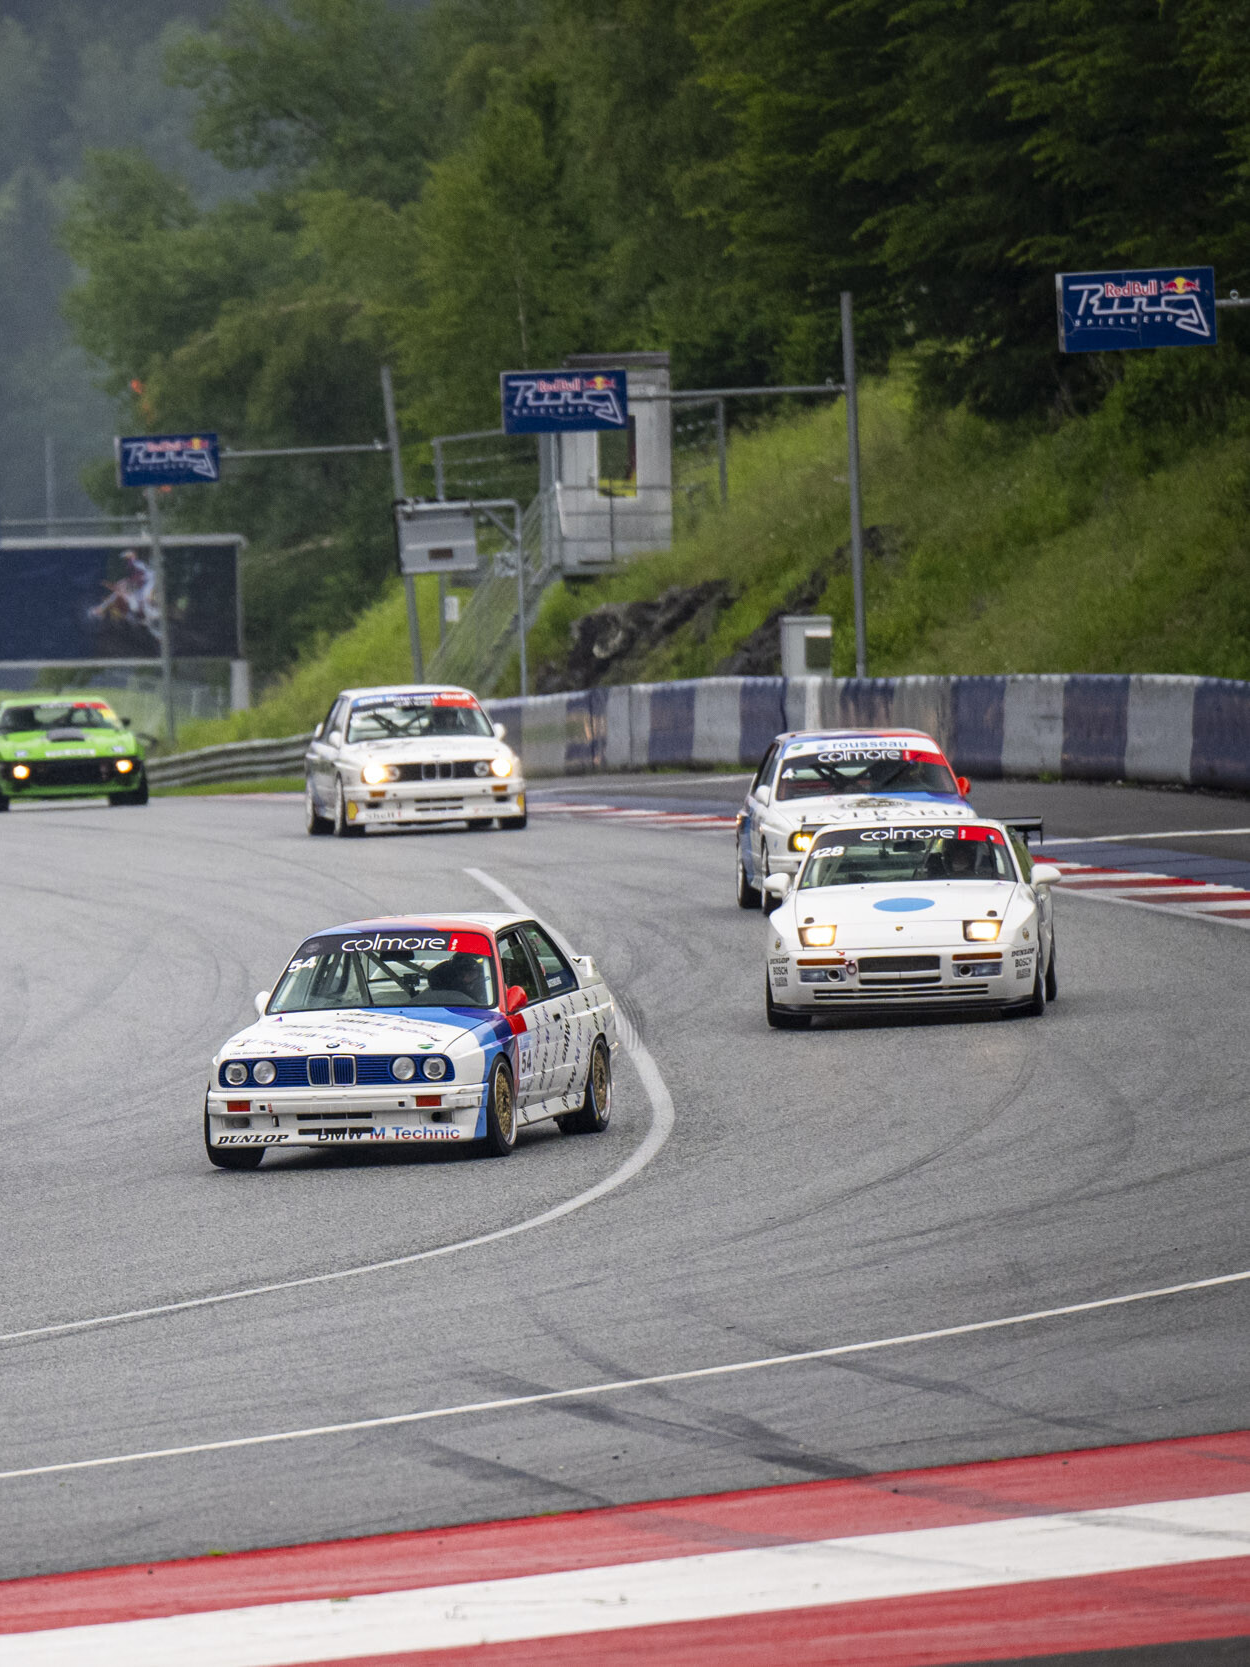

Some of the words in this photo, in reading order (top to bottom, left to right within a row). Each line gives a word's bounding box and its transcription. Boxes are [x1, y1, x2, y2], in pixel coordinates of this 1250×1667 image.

[1074, 314, 1174, 327] SPIELBERG
[832, 741, 908, 750] rousseau
[817, 750, 901, 763] colmore
[859, 827, 956, 841] colmore
[810, 846, 846, 858] 128
[341, 933, 447, 952] colmore
[287, 956, 317, 974] 54
[521, 1050, 532, 1074] 54
[217, 1134, 290, 1145] DUNLOP
[370, 1127, 387, 1140] M
[391, 1126, 461, 1141] Technic
